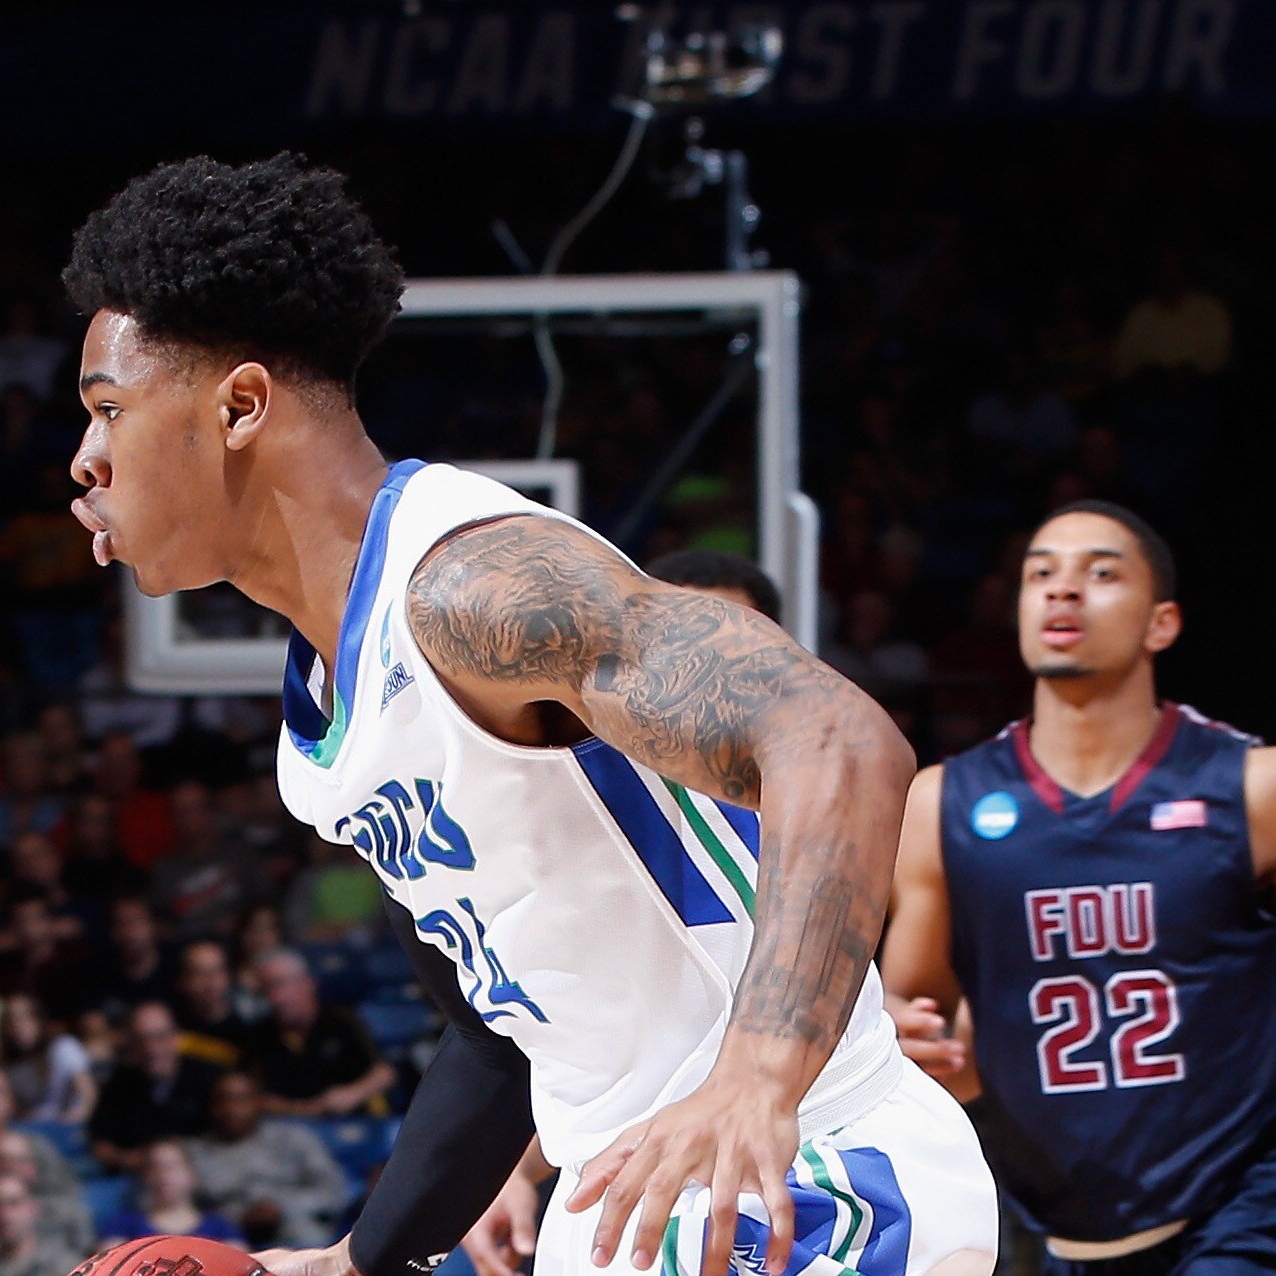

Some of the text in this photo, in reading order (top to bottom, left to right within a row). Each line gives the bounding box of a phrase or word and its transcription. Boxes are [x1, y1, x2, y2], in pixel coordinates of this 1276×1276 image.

[303, 0, 1241, 118] NCAA FST FOUR
[1024, 882, 1157, 962] FDU
[1028, 968, 1186, 1095] 22
